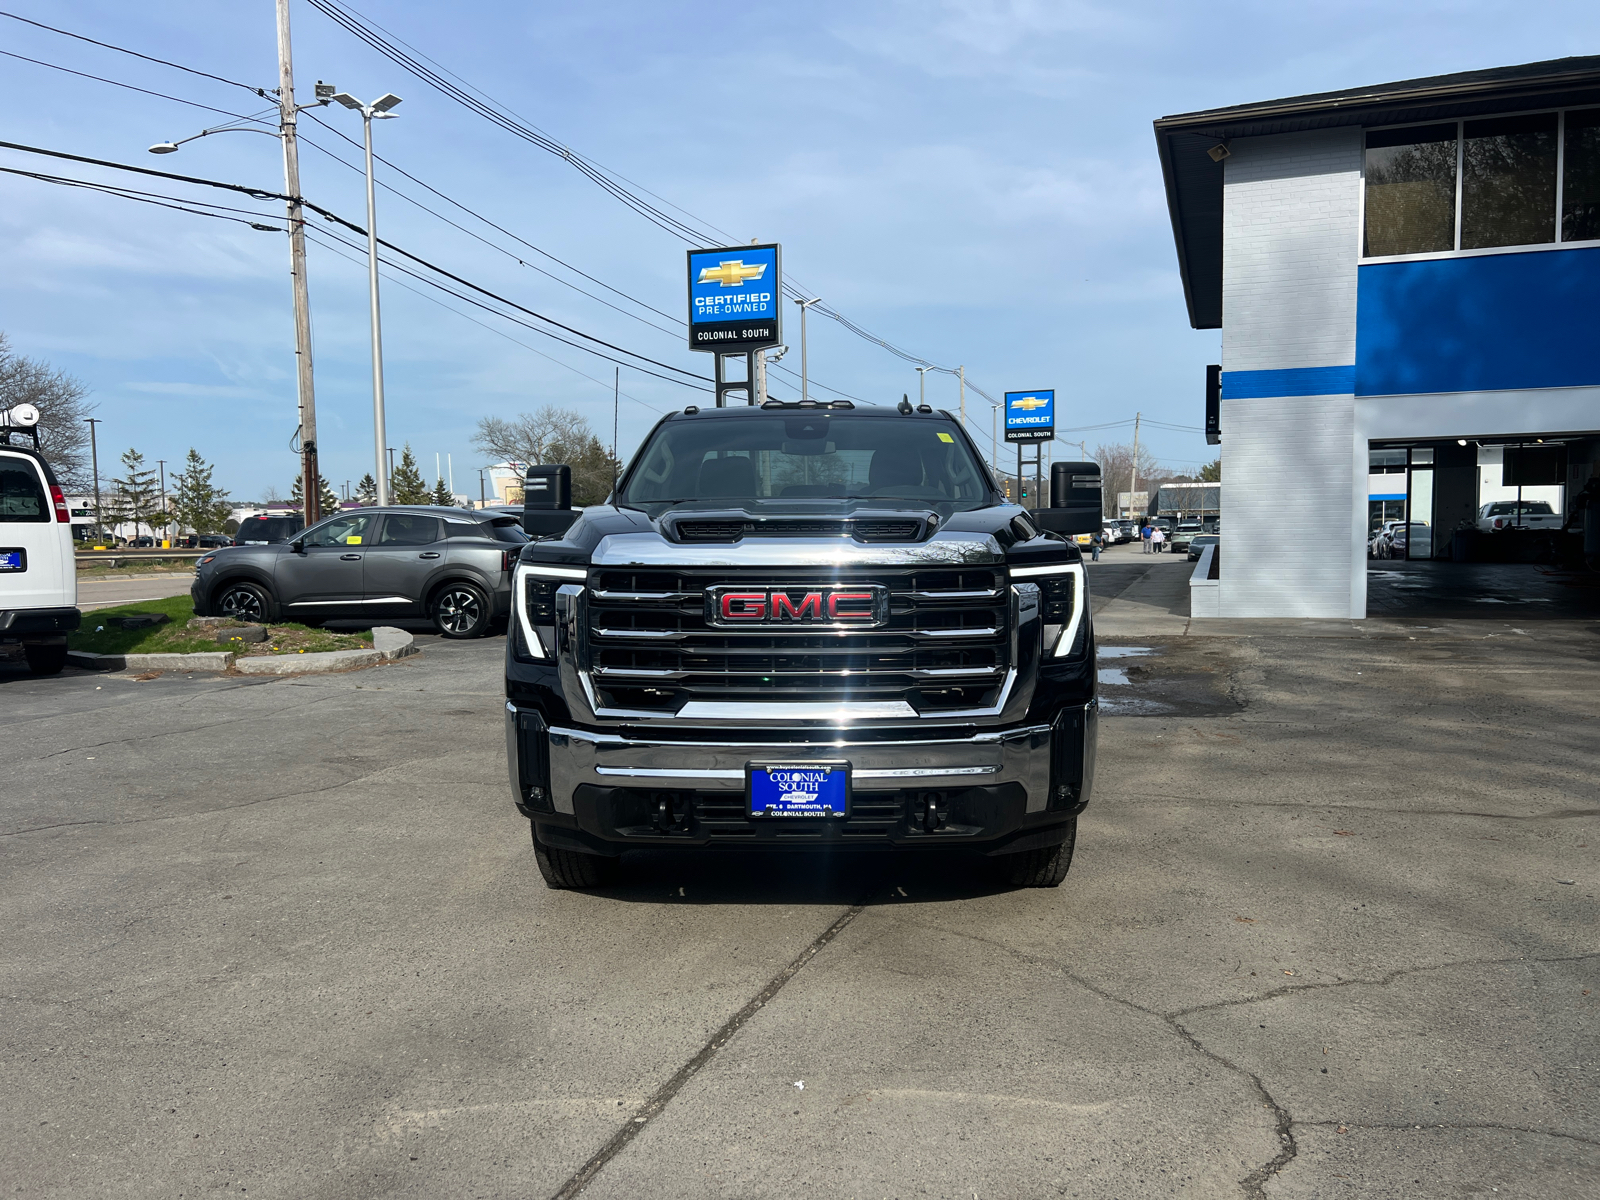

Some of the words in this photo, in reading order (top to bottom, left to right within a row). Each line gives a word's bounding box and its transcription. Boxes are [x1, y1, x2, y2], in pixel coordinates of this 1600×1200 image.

[695, 292, 771, 306] CERTIFIED
[698, 302, 767, 315] PRE-OWNED
[697, 330, 738, 341] COLONIAL
[742, 328, 769, 338] SOUTH
[1008, 416, 1051, 425] CHEVROLET
[720, 592, 874, 621] GMC
[769, 772, 828, 782] COLONIAL
[778, 782, 819, 792] SOUTH
